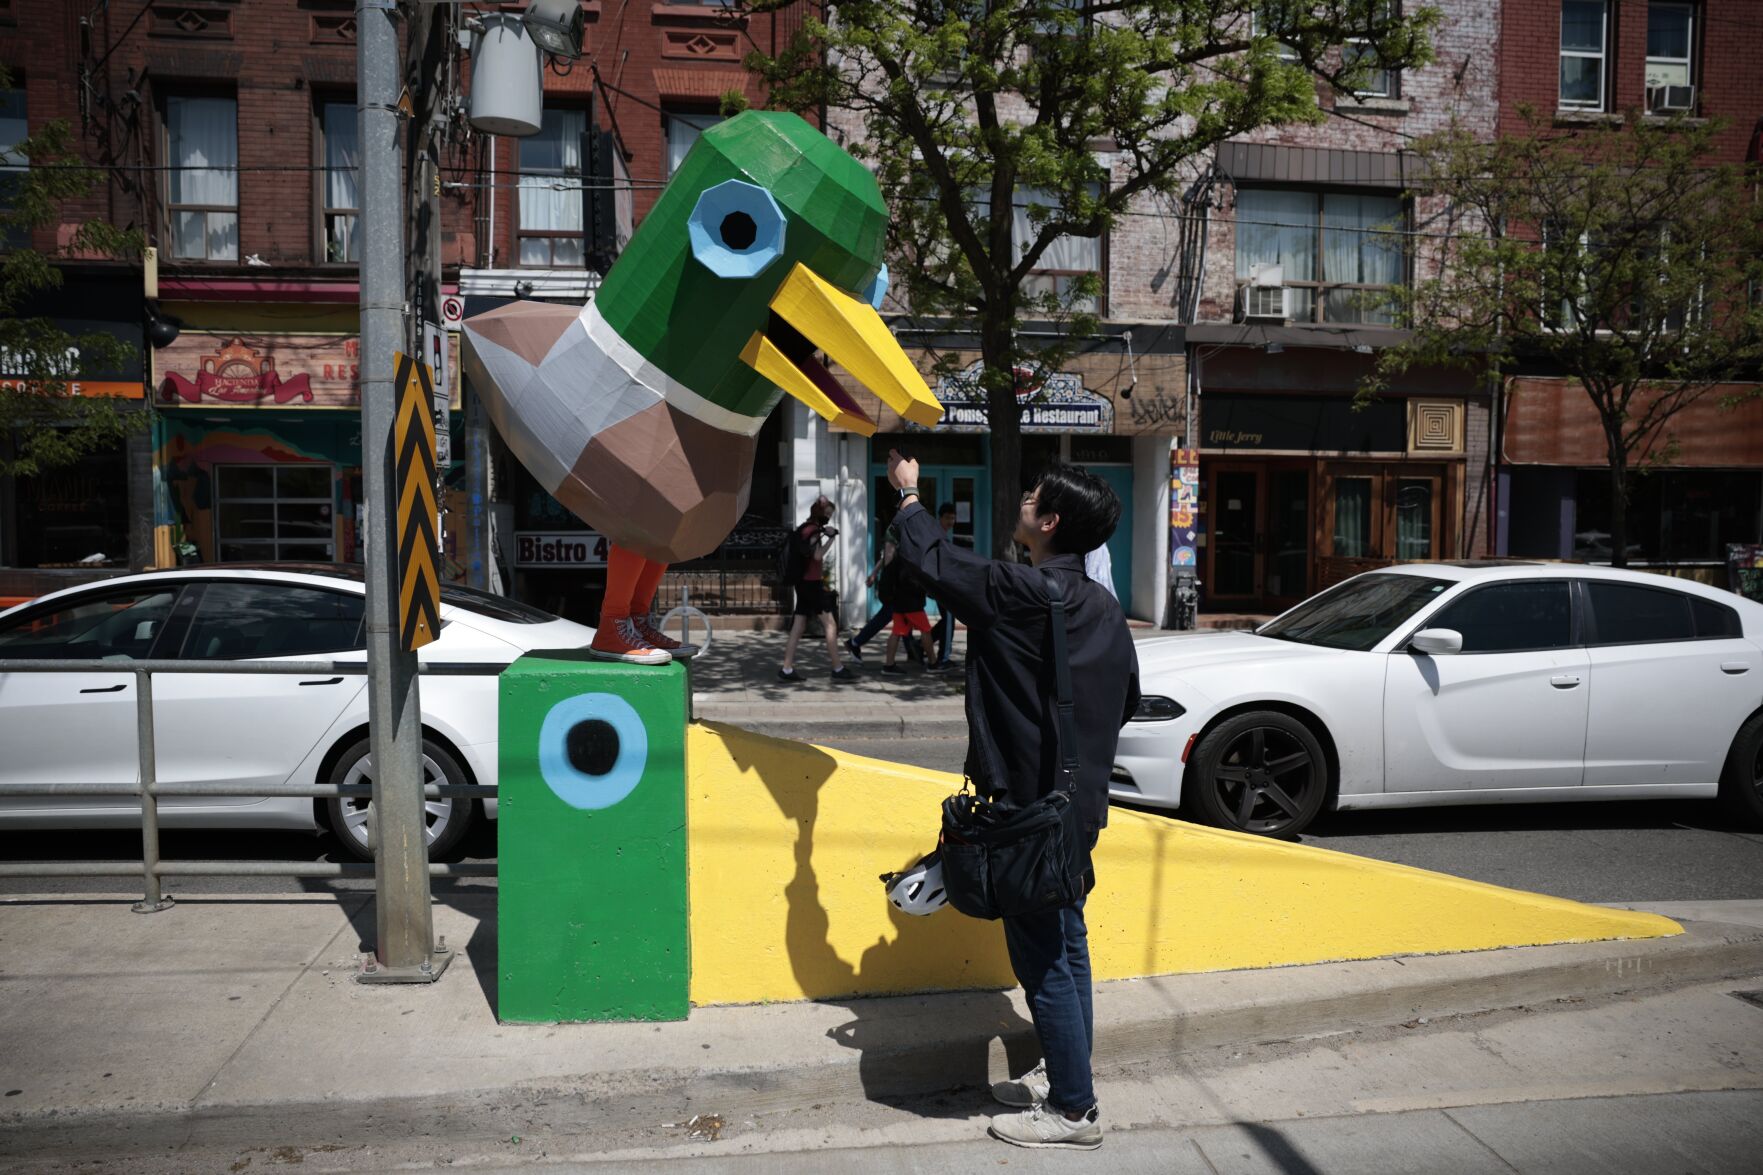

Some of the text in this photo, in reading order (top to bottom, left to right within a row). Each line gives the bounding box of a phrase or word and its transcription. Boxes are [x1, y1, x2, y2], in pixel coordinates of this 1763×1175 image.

[1033, 408, 1099, 424] Restaurant
[1209, 430, 1263, 445] Little Jerry
[519, 537, 611, 562] Bistro 4
